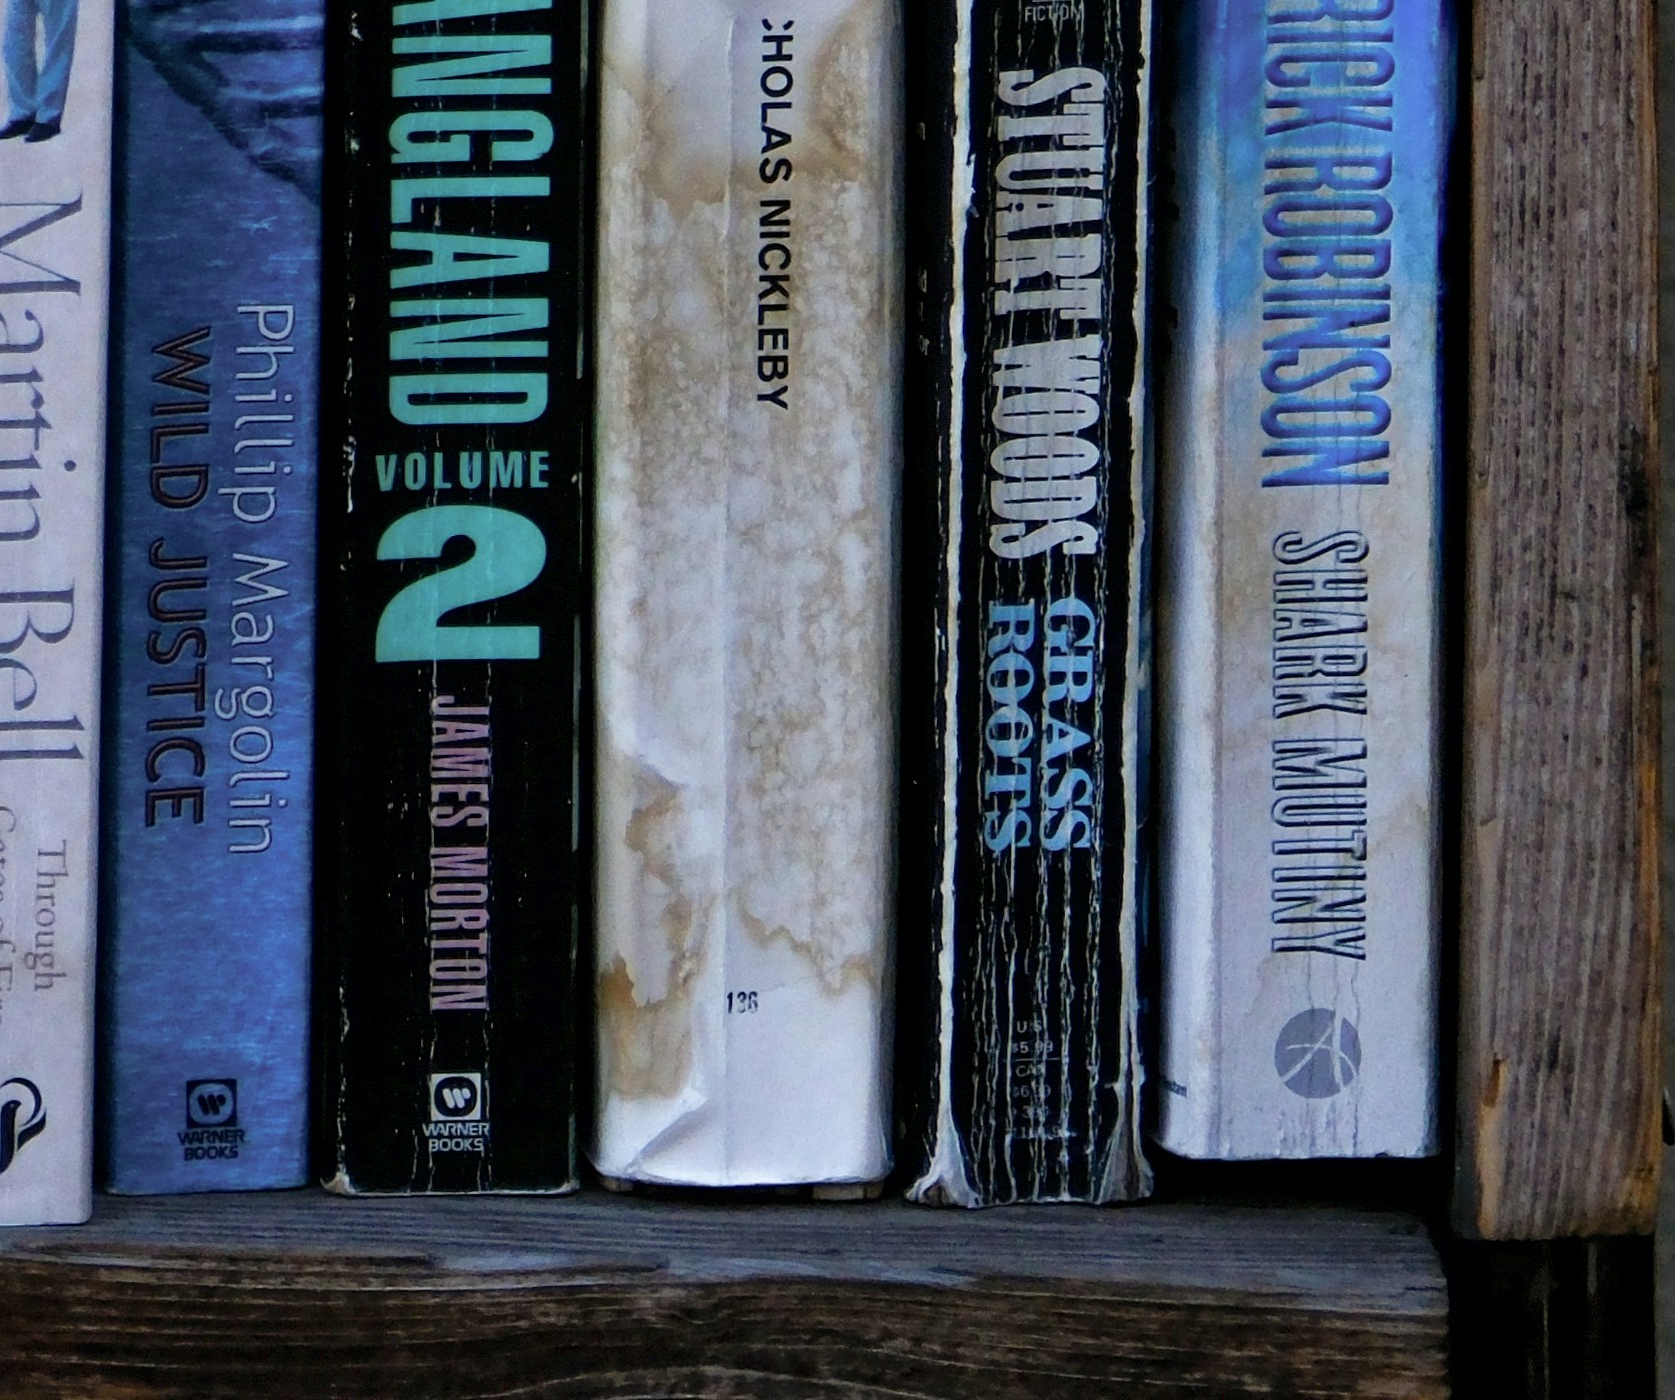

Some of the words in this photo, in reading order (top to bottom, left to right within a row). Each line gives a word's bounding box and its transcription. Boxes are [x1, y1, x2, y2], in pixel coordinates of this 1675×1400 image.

[754, 196, 792, 413] NICKLEBY
[993, 66, 1107, 331] STUART
[150, 325, 212, 513] WILD
[216, 301, 298, 525] Phillip
[1258, 148, 1394, 491] ROBINSON
[988, 338, 1101, 560] WOODS
[142, 538, 208, 828] JUSTICE
[373, 502, 548, 665] 2
[1270, 529, 1370, 720] SHARK
[212, 550, 291, 858] Margolin
[1038, 596, 1098, 852] GRASS
[1270, 734, 1369, 961] MUTINY
[182, 1144, 240, 1161] BOOKS
[426, 1137, 485, 1153] BOOKS
